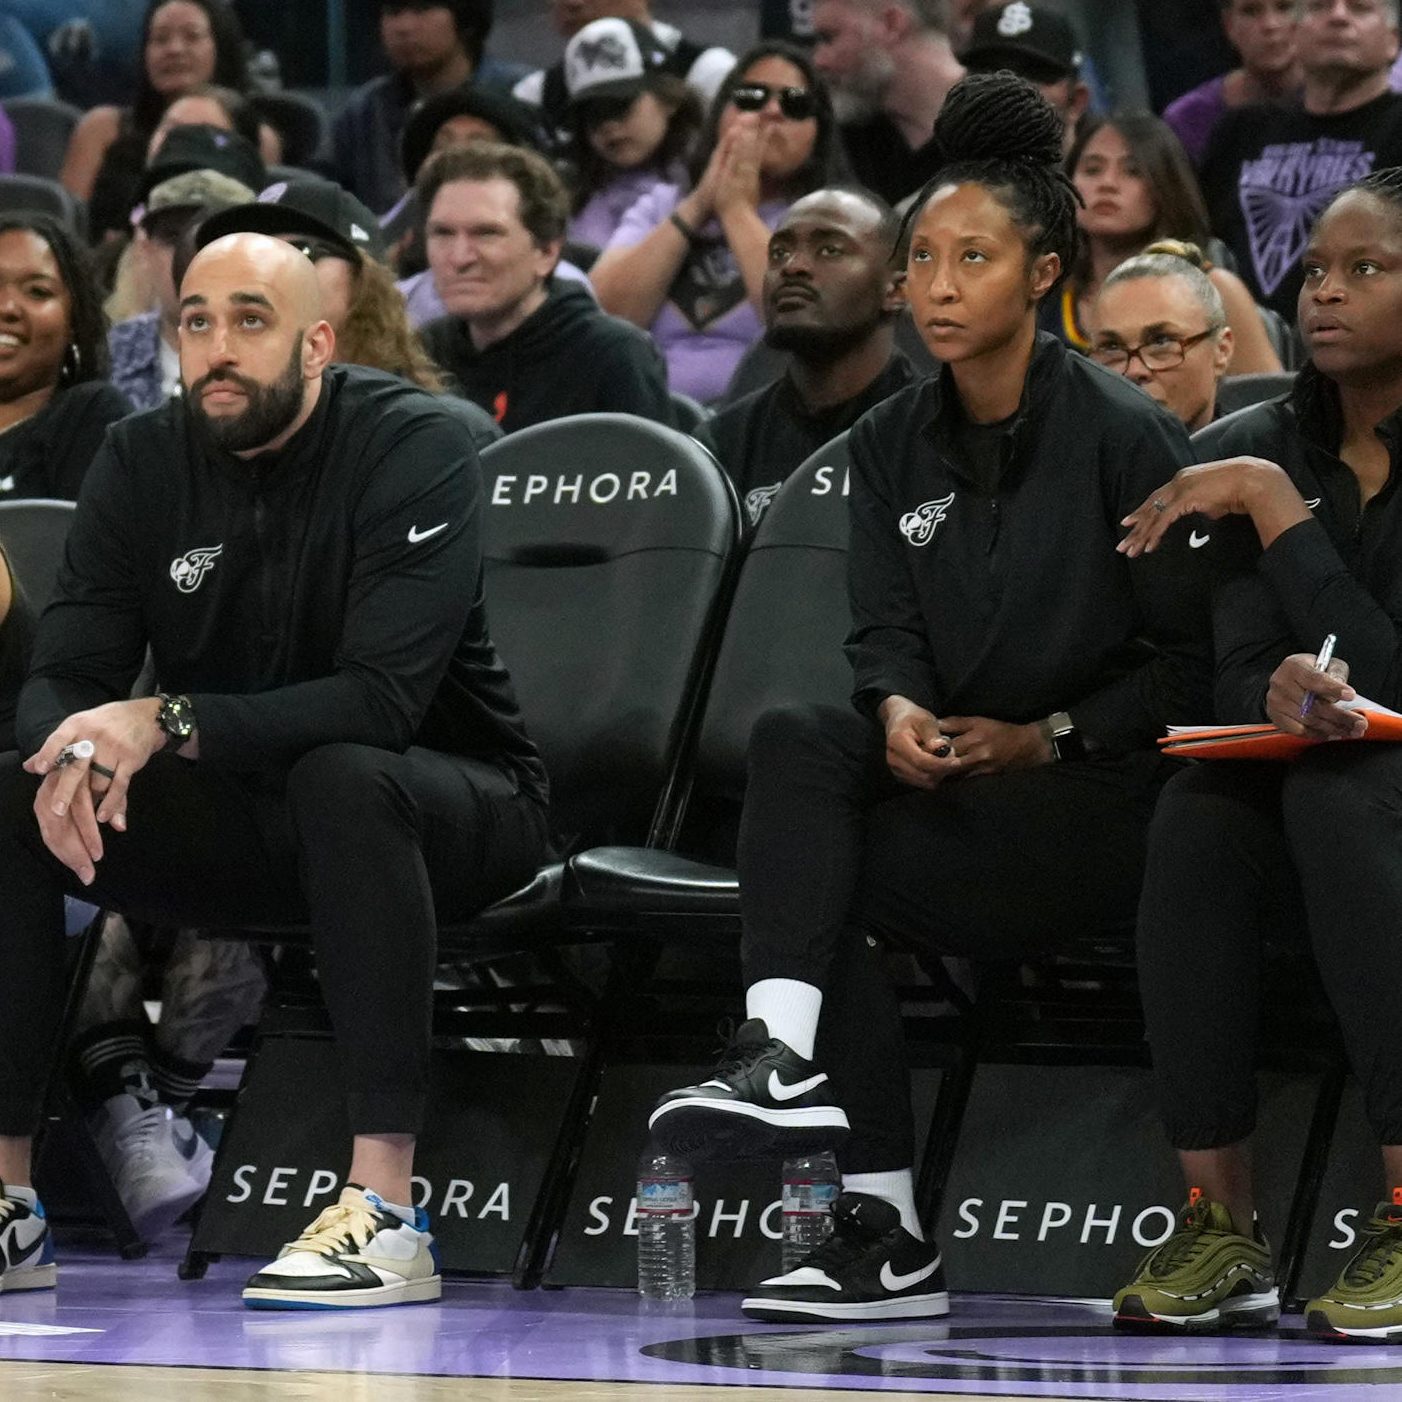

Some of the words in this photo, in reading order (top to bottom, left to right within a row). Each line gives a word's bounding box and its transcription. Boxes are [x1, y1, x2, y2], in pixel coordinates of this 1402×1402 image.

[492, 469, 678, 505] EPHORA
[226, 1164, 510, 1222] SEPORA
[953, 1197, 1177, 1248] SEPHO
